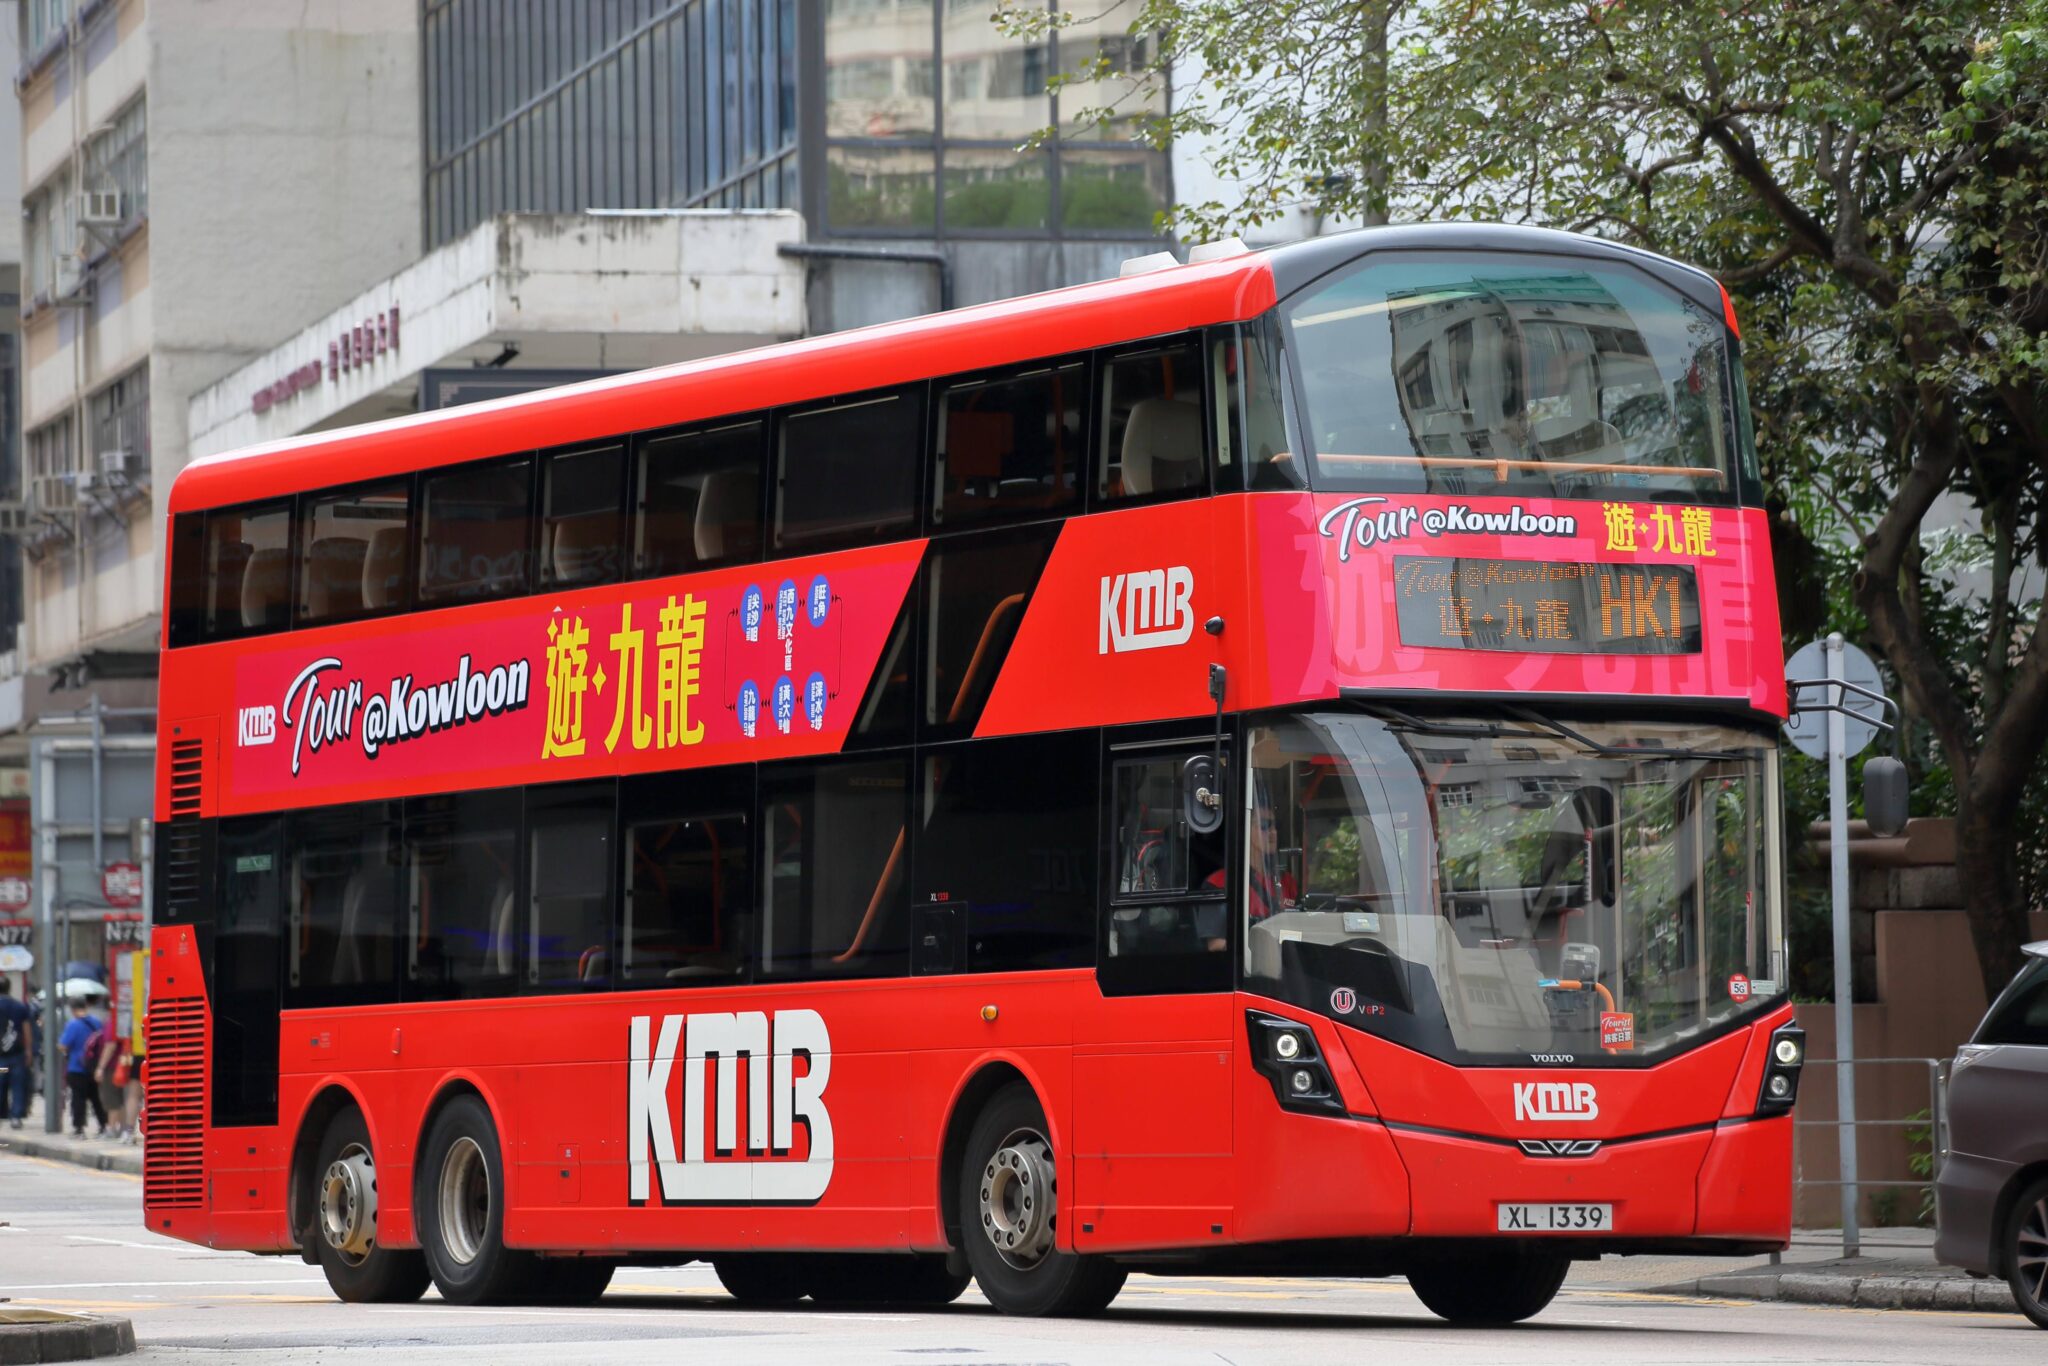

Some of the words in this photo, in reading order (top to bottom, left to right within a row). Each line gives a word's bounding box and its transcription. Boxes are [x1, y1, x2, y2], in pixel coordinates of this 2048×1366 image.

[818, 584, 827, 618] 旺角
[1099, 565, 1194, 655] KMB
[1602, 574, 1682, 639] HK1
[238, 705, 276, 747] KMB
[1530, 1054, 1574, 1063] VOLVO
[628, 1009, 835, 1208] KMB
[1513, 1082, 1599, 1121] KMB
[1508, 1206, 1537, 1228] XL
[1550, 1206, 1603, 1228] 1339
